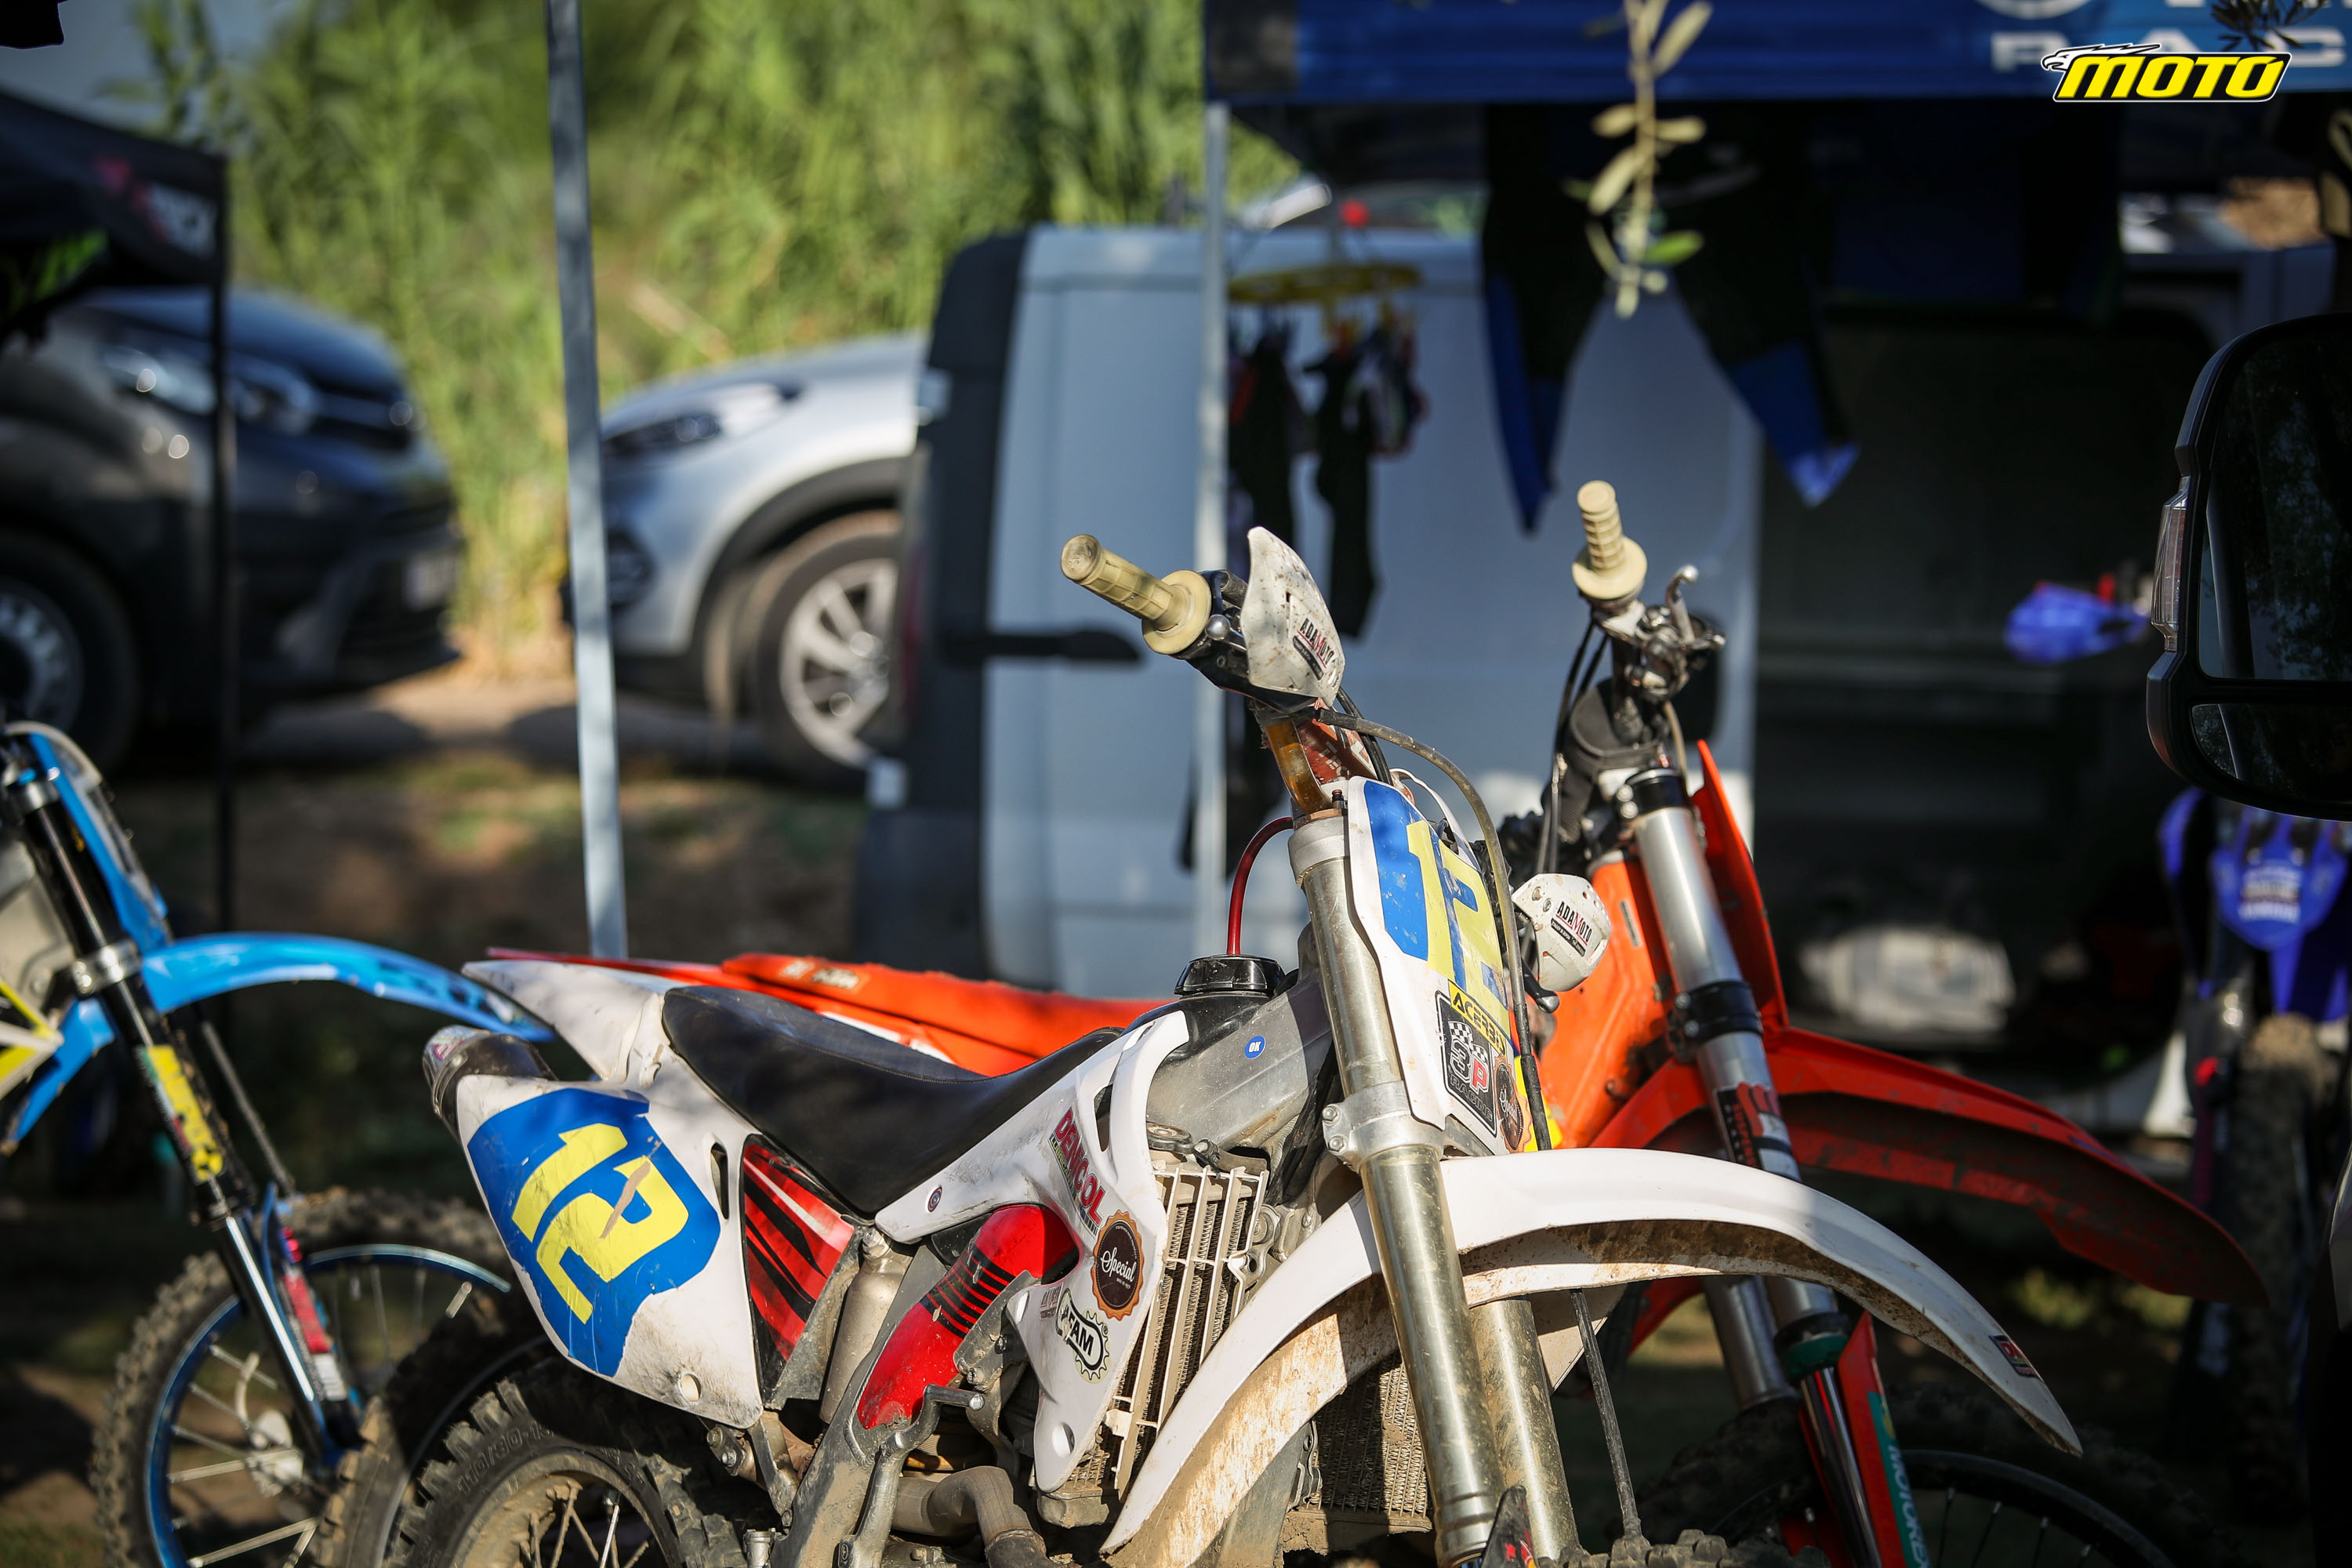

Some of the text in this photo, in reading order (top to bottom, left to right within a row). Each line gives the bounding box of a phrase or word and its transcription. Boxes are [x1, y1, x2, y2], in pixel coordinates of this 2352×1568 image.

[1298, 617, 1334, 668] ADAMOTO
[1556, 900, 1592, 946] ADAMOTO
[1248, 1041, 1261, 1052] OK
[1450, 1036, 1490, 1094] 3P
[1450, 1073, 1494, 1123] RACING
[512, 1123, 689, 1325] 12
[1100, 1247, 1137, 1283] Special
